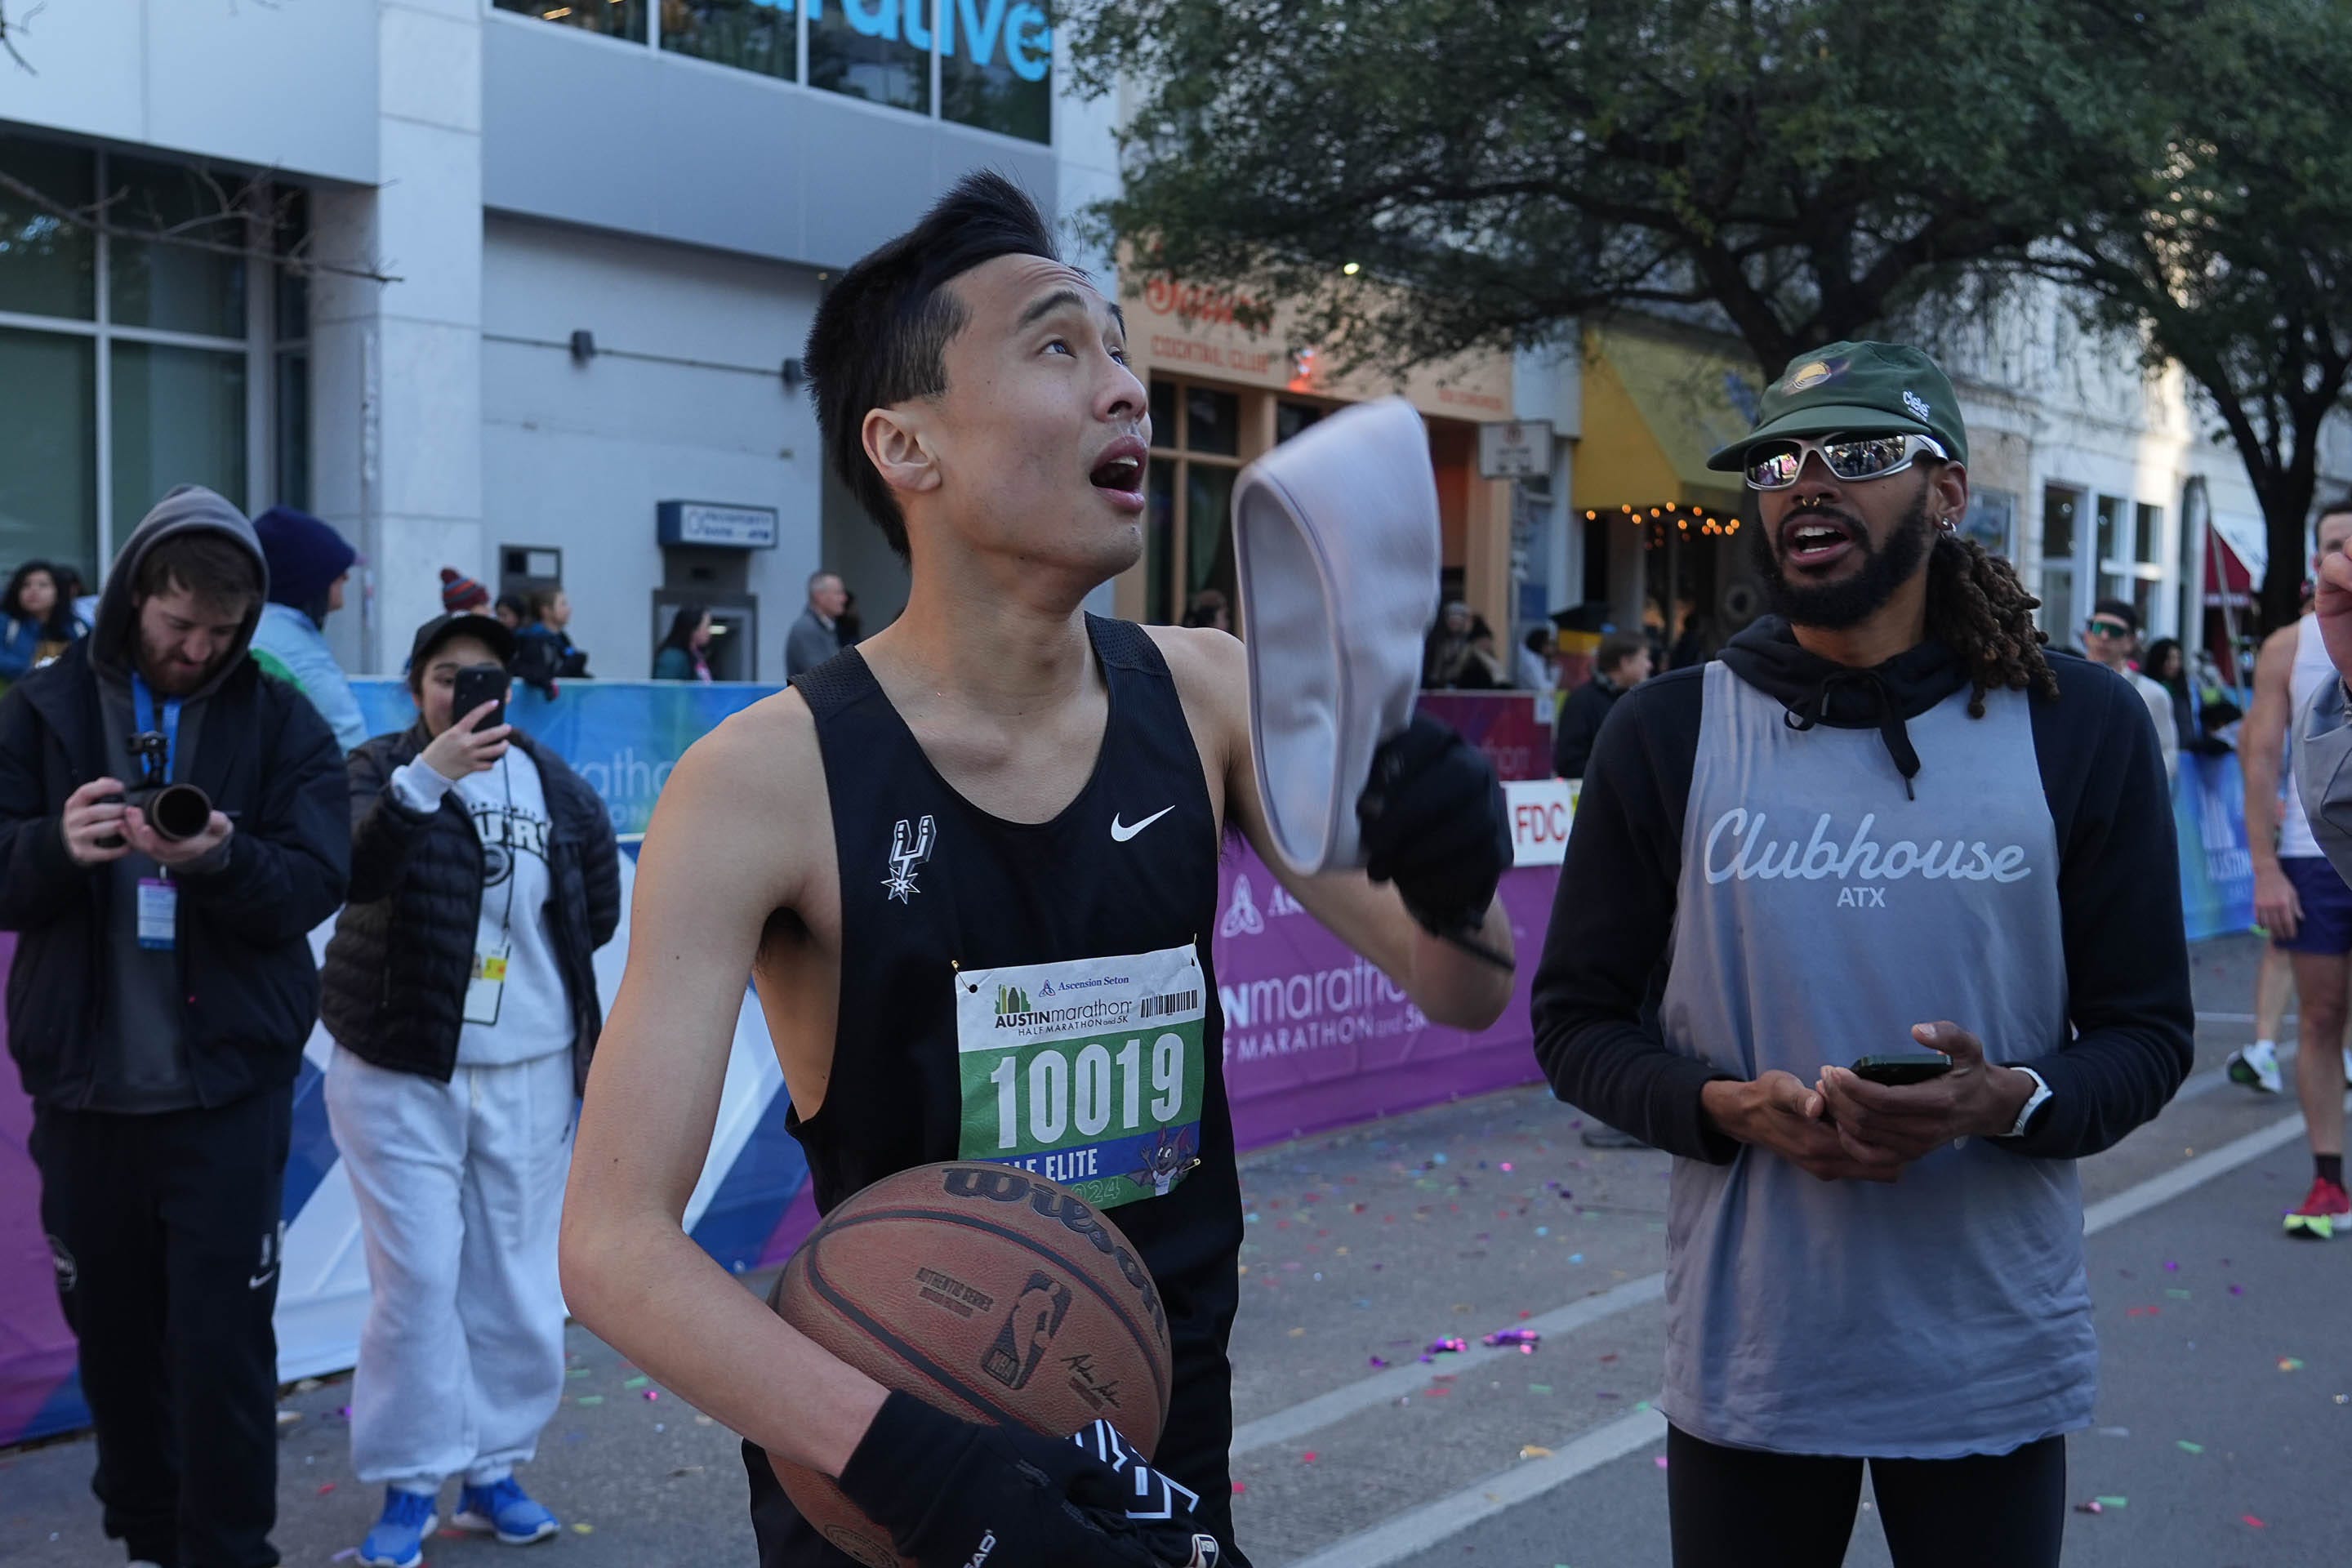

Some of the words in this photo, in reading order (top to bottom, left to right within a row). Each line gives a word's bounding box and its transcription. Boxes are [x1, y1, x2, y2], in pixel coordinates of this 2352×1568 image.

[1704, 807, 2032, 884] Clubhouse
[1837, 887, 1886, 907] ATX
[1058, 979, 1102, 991] Ascension
[1103, 976, 1129, 985] Seton
[1018, 1026, 1045, 1036] HALF
[1045, 1020, 1102, 1034] MARATHON
[1116, 1014, 1129, 1024] 5K
[1237, 1016, 1374, 1061] MARATHON
[991, 1032, 1184, 1149] 10019
[1045, 1148, 1098, 1182] ELITE
[1071, 1176, 1121, 1205] 024
